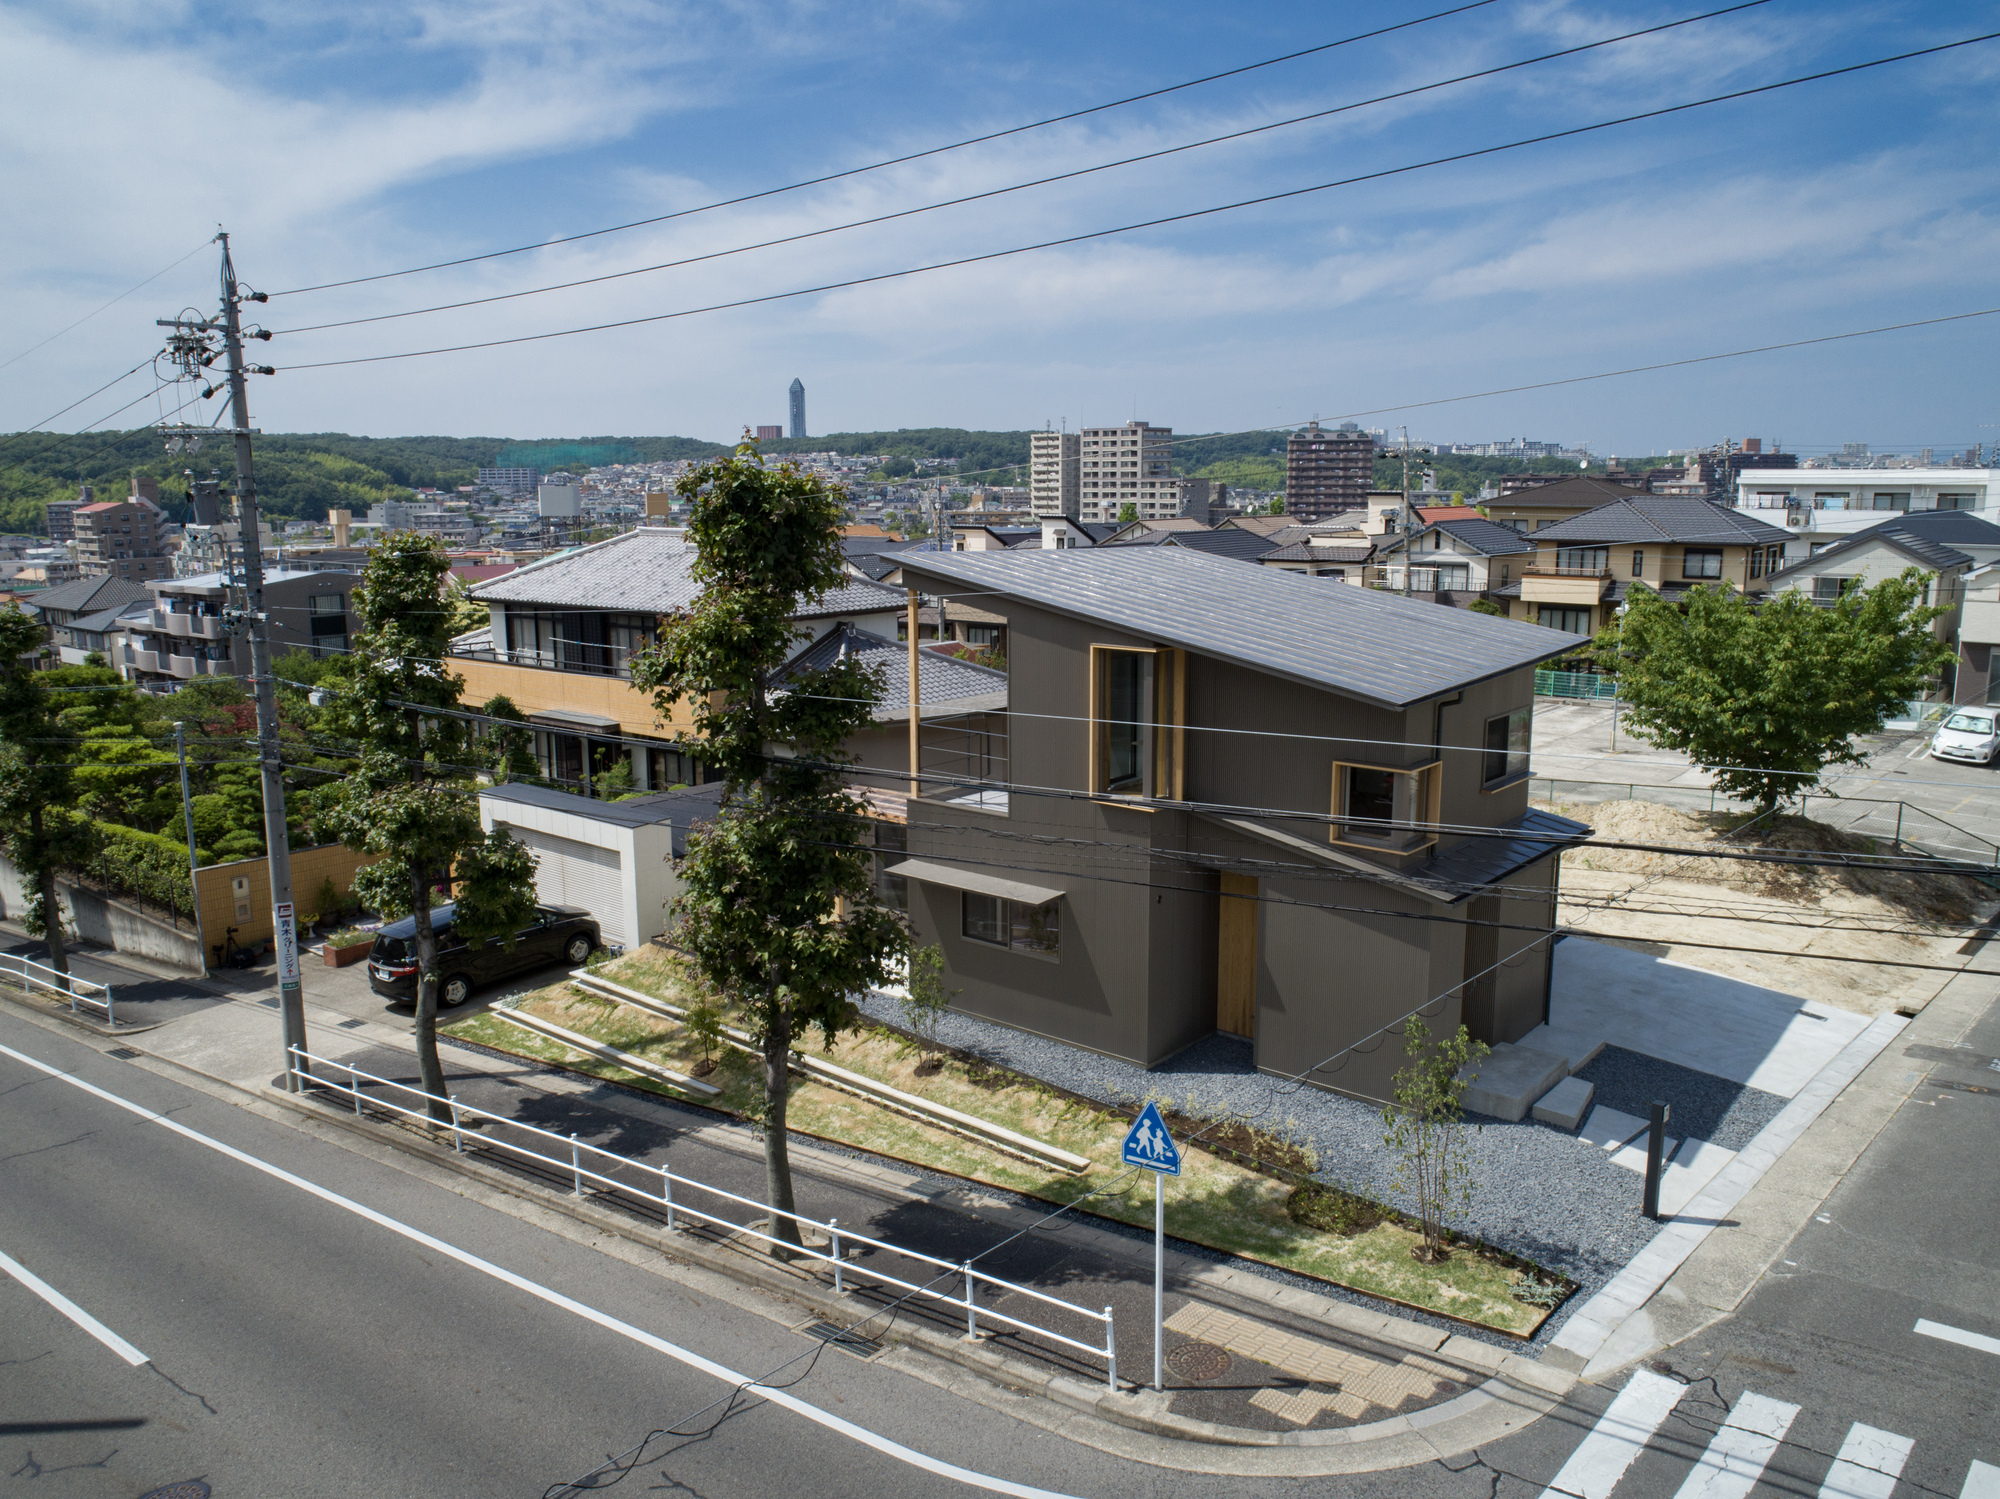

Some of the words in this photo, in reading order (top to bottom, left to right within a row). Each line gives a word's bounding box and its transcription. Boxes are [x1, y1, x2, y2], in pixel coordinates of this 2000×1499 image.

[281, 919, 294, 969] 青木クリーニング
